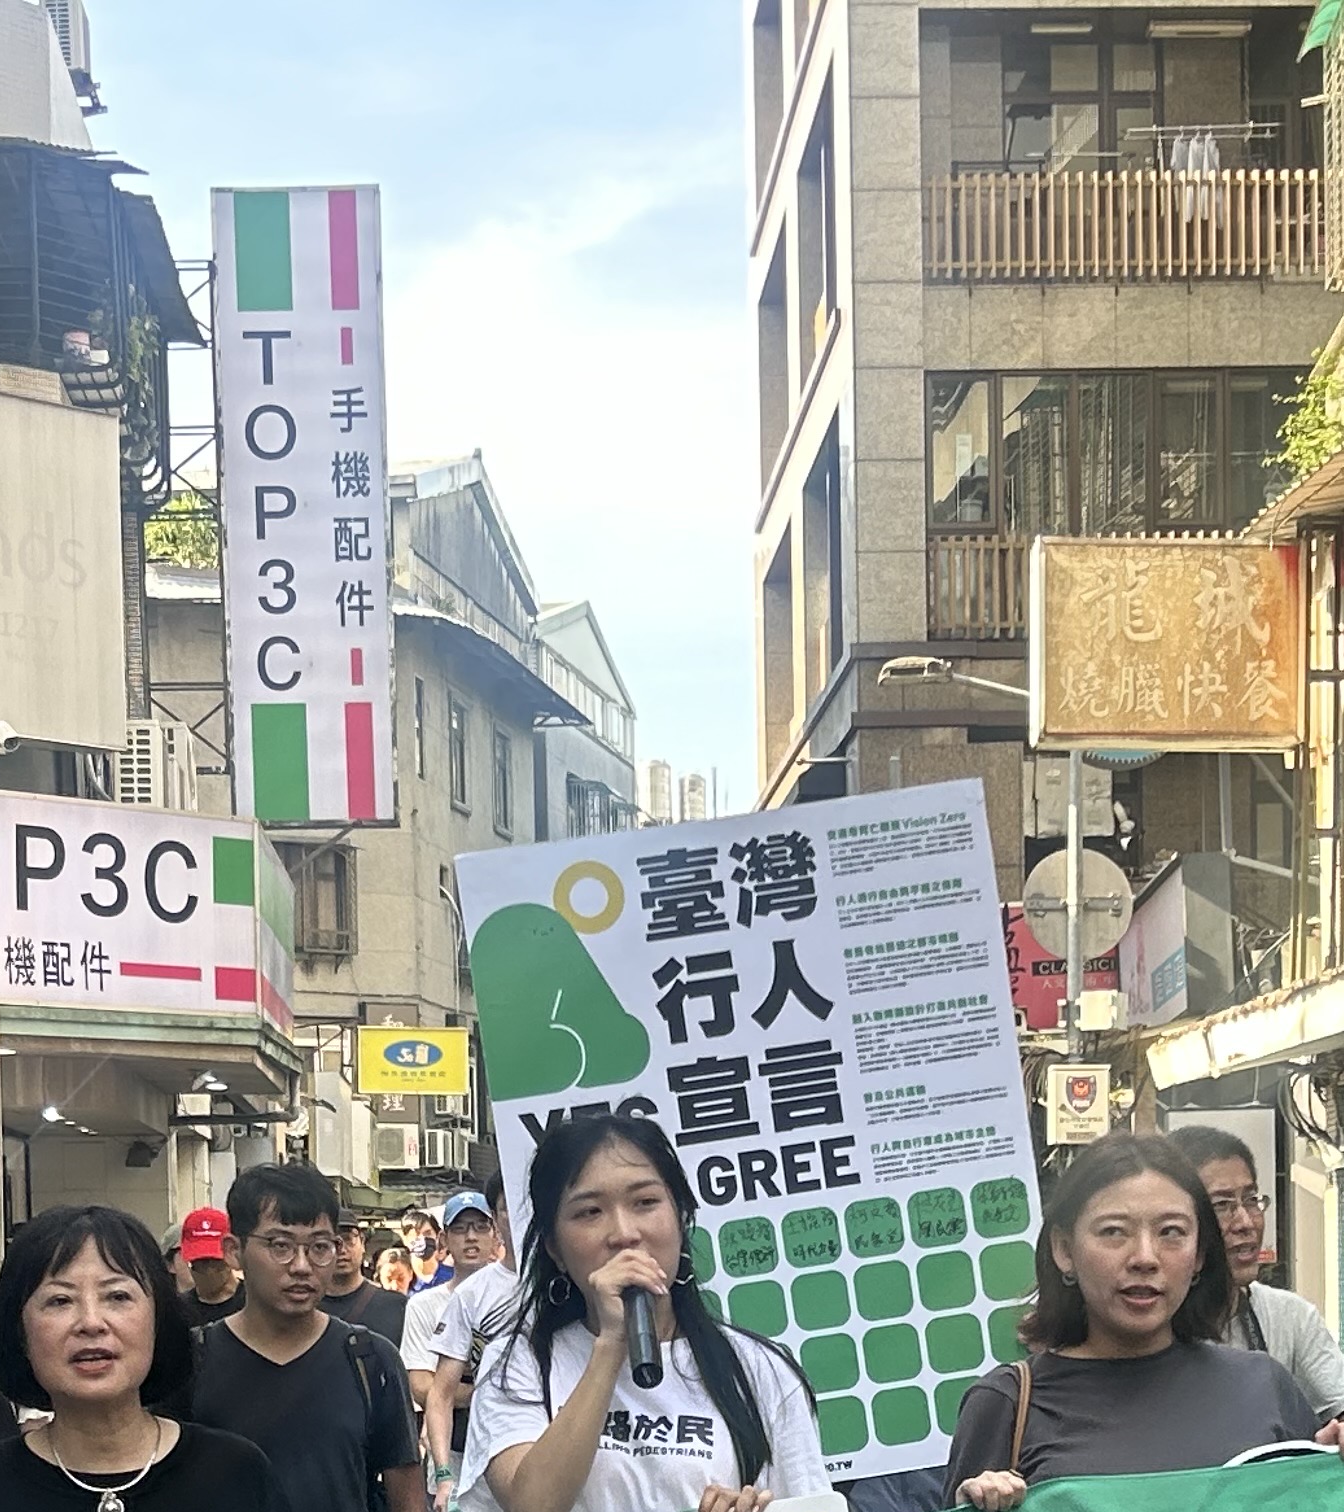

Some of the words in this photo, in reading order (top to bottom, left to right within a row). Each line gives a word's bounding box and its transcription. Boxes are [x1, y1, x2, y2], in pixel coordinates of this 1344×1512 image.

[241, 329, 302, 692] TOP3C
[329, 387, 375, 629] 手機配件
[1058, 660, 1289, 724] 燒臘快餐
[635, 830, 820, 945] 臺灣
[3, 935, 113, 993] 機配件
[650, 938, 835, 1045] 行人
[666, 1039, 845, 1147] 宣言
[690, 1135, 862, 1209] GREE
